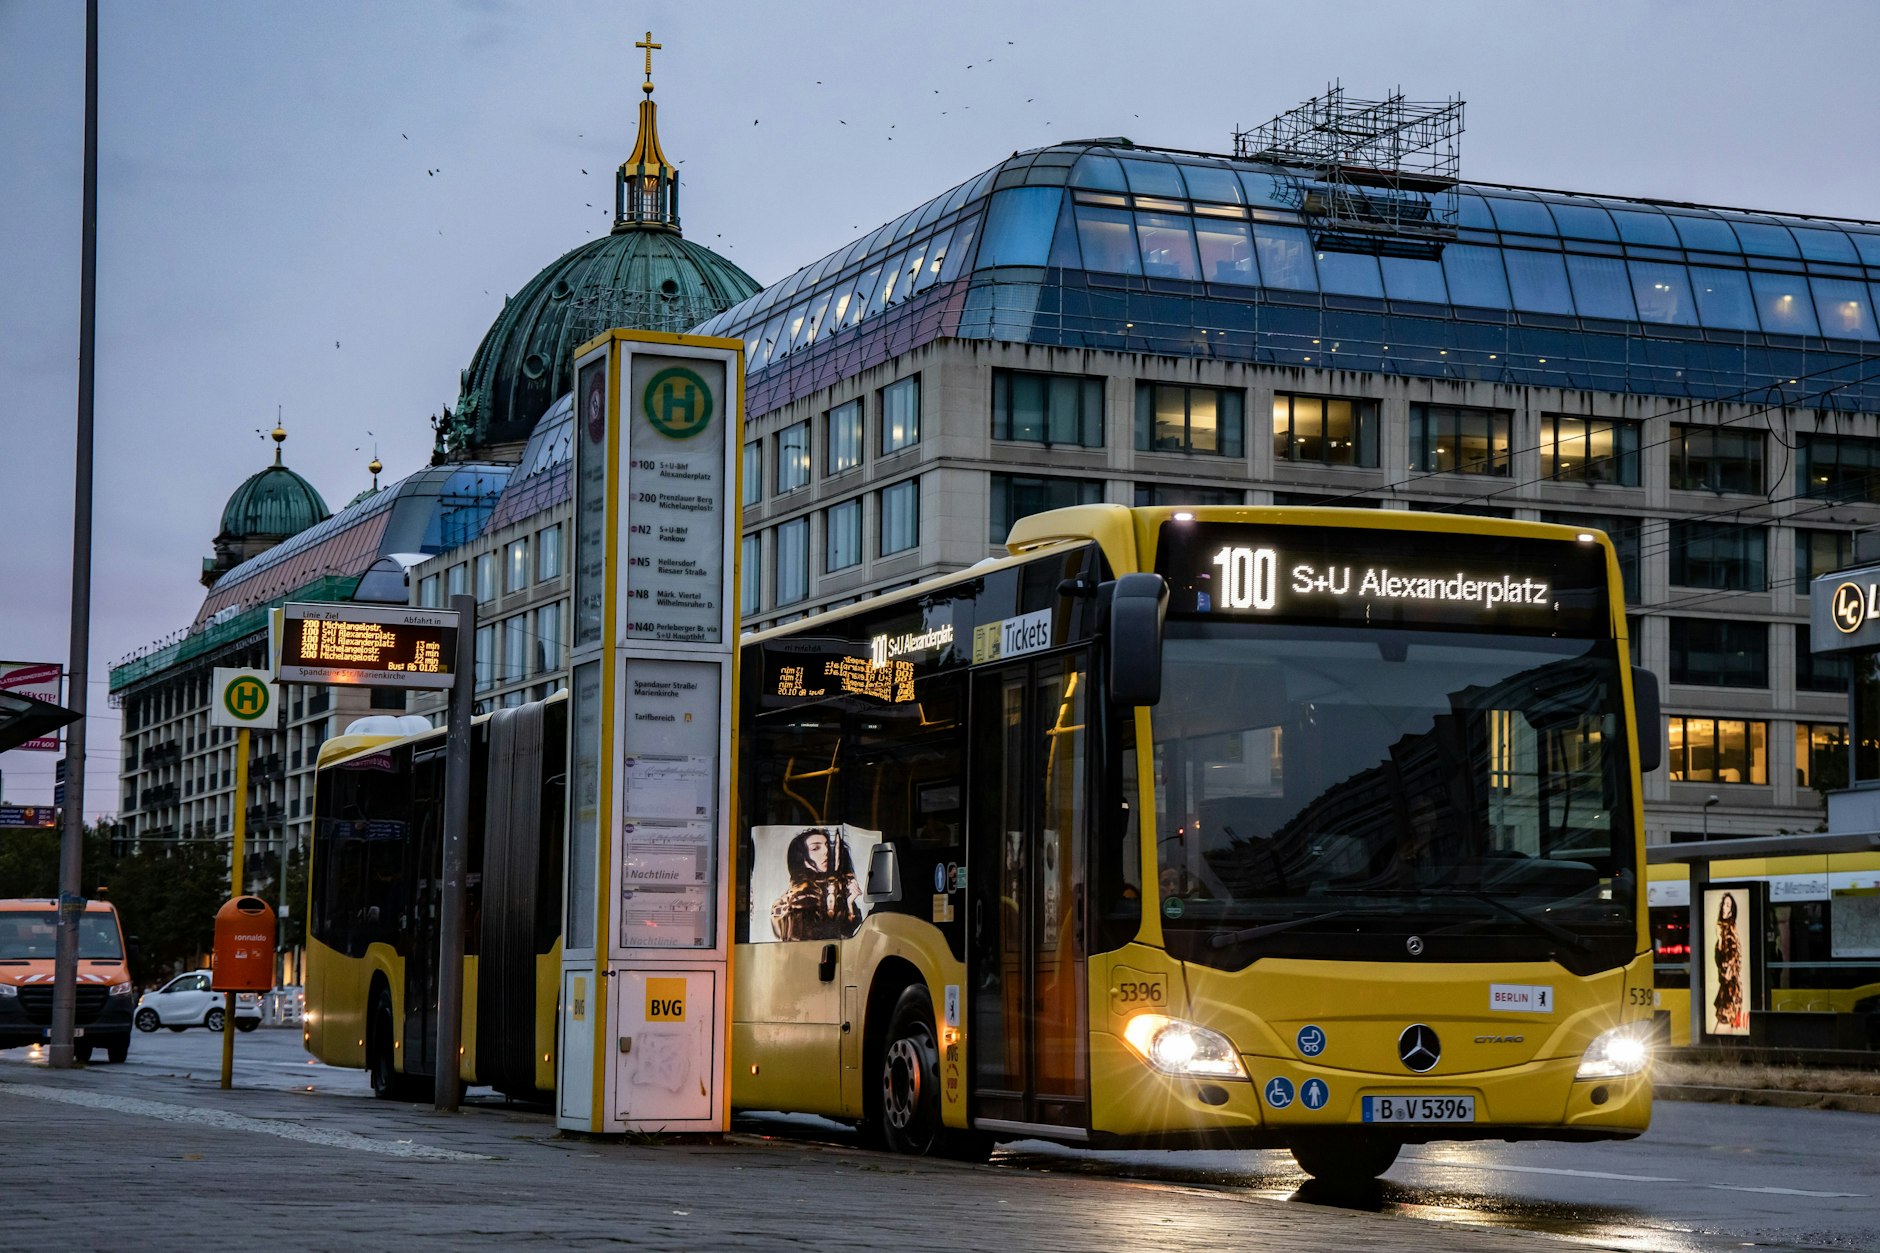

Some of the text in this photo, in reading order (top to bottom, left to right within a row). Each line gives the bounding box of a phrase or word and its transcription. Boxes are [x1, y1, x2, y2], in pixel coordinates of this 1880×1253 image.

[663, 384, 695, 422] H
[639, 461, 688, 470] 100 S+U-Bhf
[660, 470, 711, 480] Alexanderplatz
[639, 492, 713, 505] 200 Prenzlauer Berg
[659, 502, 715, 512] Michelangelostr.
[638, 525, 688, 535] N2 S+U-Bhf
[659, 534, 686, 543] Pankow
[637, 557, 696, 567] N5 Hellersdorf
[658, 566, 707, 576] Riesaer Straße
[1214, 547, 1547, 609] 100 S+U Alexanderplatz
[636, 589, 701, 600] N8 Märk. Viertel
[657, 599, 715, 609] Wilhelmsruher D.
[302, 620, 382, 632] 200 Michelangelostr.
[403, 616, 441, 625] Abfahrt in
[302, 627, 396, 640] 100 S+U Alexanderplatz
[635, 622, 654, 632] N40
[656, 623, 695, 634] Perleberger
[672, 633, 706, 641] Hauptbhf.
[1005, 618, 1048, 653] Tickets
[301, 635, 440, 650] 100 S+U Alexanderplatz 13 min
[301, 642, 318, 651] 200
[320, 643, 380, 654] Michelangelostr.
[425, 649, 439, 657] min
[871, 634, 887, 670] 100
[888, 635, 904, 658] S+U
[300, 650, 439, 665] 200 Michelangelostr. 22 min
[299, 667, 340, 677] Spandauer
[387, 662, 405, 671] Bus:
[407, 663, 417, 672] Ab
[634, 680, 698, 690] Spandauer Straße/
[237, 686, 258, 710] H
[634, 688, 679, 697] Marienkirche
[635, 713, 676, 722] Tarifbereich
[631, 870, 680, 880] Nachtlinie
[629, 936, 678, 946] Nachtlinie
[1120, 982, 1161, 1002] 5396
[1495, 992, 1528, 1003] BERLIN
[574, 999, 585, 1016] BVG
[651, 1000, 682, 1016] BVG
[1381, 1099, 1467, 1119] B V 5396
